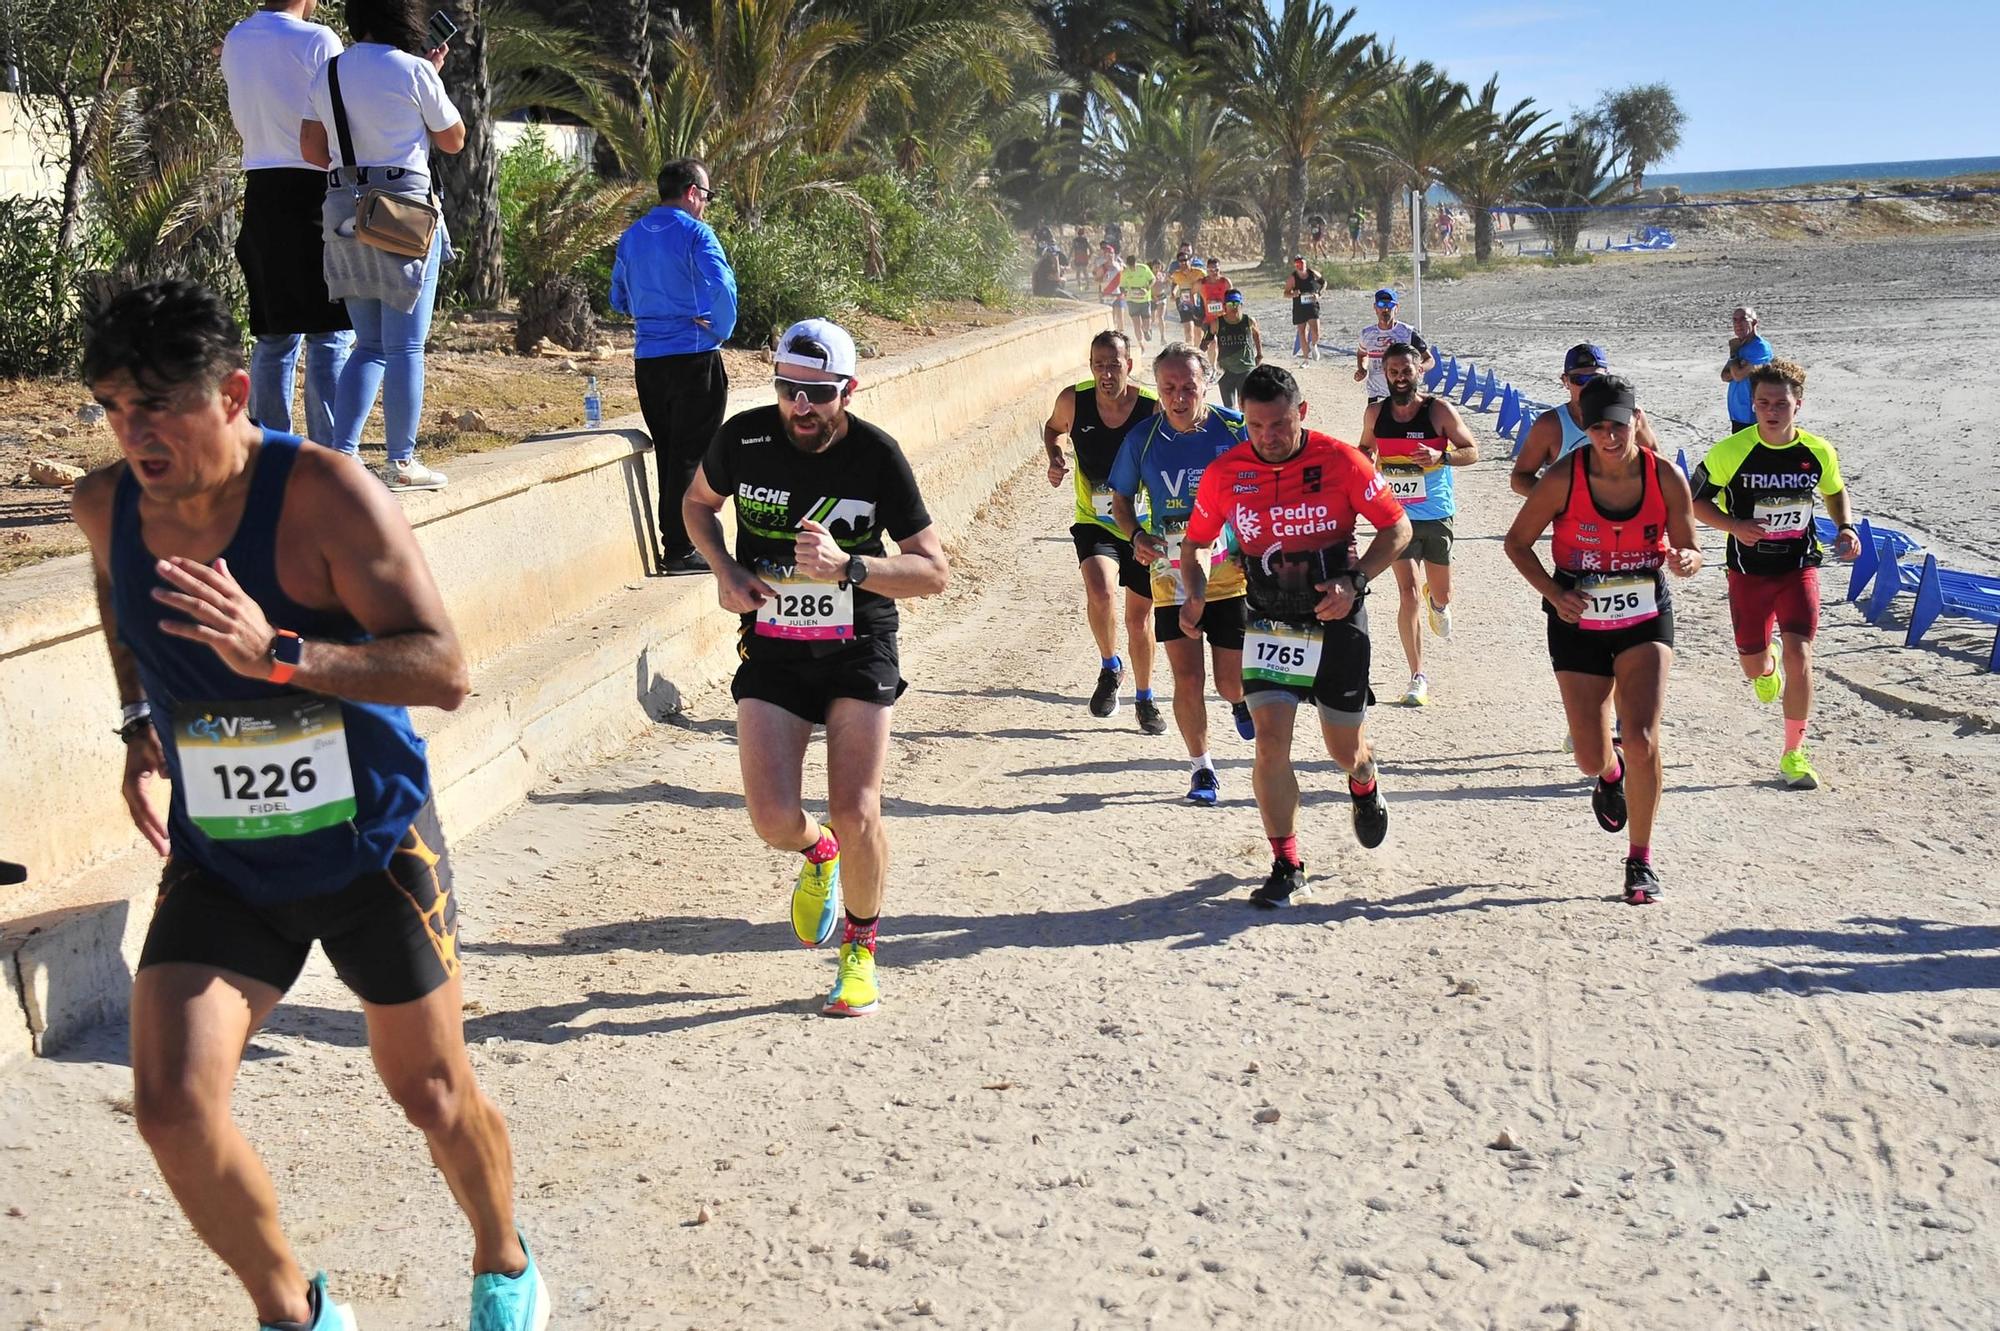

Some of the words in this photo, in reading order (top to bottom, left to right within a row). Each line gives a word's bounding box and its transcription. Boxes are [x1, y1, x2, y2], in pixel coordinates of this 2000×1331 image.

[741, 436, 764, 445] luanvi
[1160, 469, 1186, 497] V
[1740, 473, 1819, 489] TRIARIOS
[738, 482, 791, 505] ELCHE
[738, 496, 789, 515] NIGHT
[739, 504, 764, 524] RACE
[1269, 503, 1328, 521] Pedro
[1271, 519, 1338, 537] Cerdán
[1766, 511, 1802, 527] 1773
[774, 594, 834, 617] 1286
[1591, 592, 1639, 613] 1756
[788, 619, 818, 627] JULIEN
[1257, 642, 1305, 667] 1765
[1266, 663, 1290, 672] PEDRO
[221, 716, 239, 737] V
[213, 756, 318, 800] 1226
[249, 801, 292, 814] FIDEL
